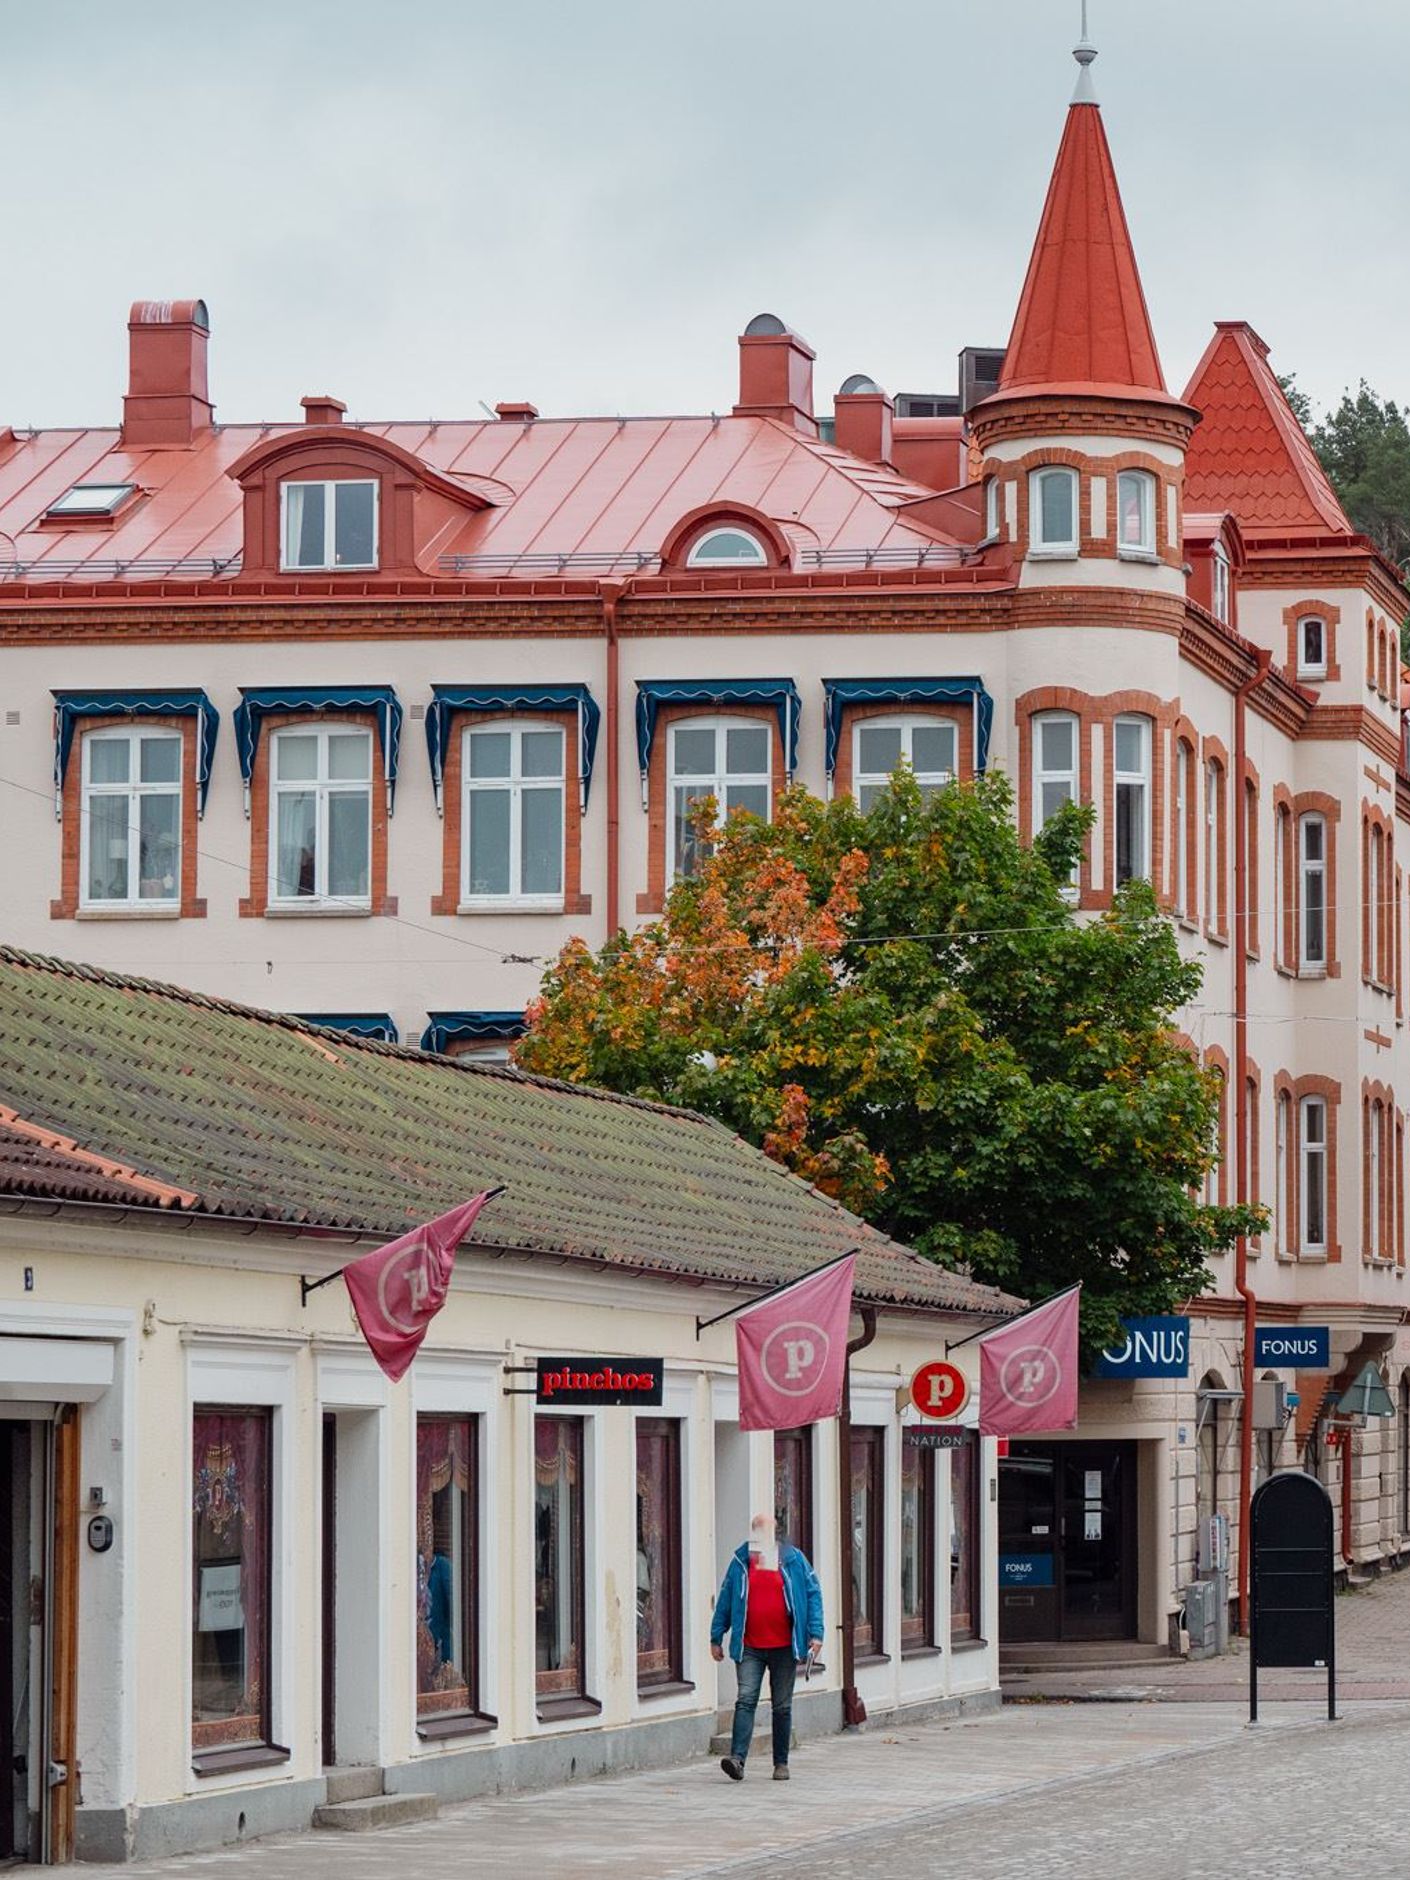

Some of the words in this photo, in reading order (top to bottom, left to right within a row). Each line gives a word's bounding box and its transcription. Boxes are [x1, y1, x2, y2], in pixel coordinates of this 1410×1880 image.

[1102, 1330, 1185, 1364] ONUS
[1262, 1339, 1318, 1355] FONUS
[542, 1366, 654, 1396] pinchos
[910, 1435, 963, 1446] NATION
[1006, 1563, 1033, 1573] FONUS
